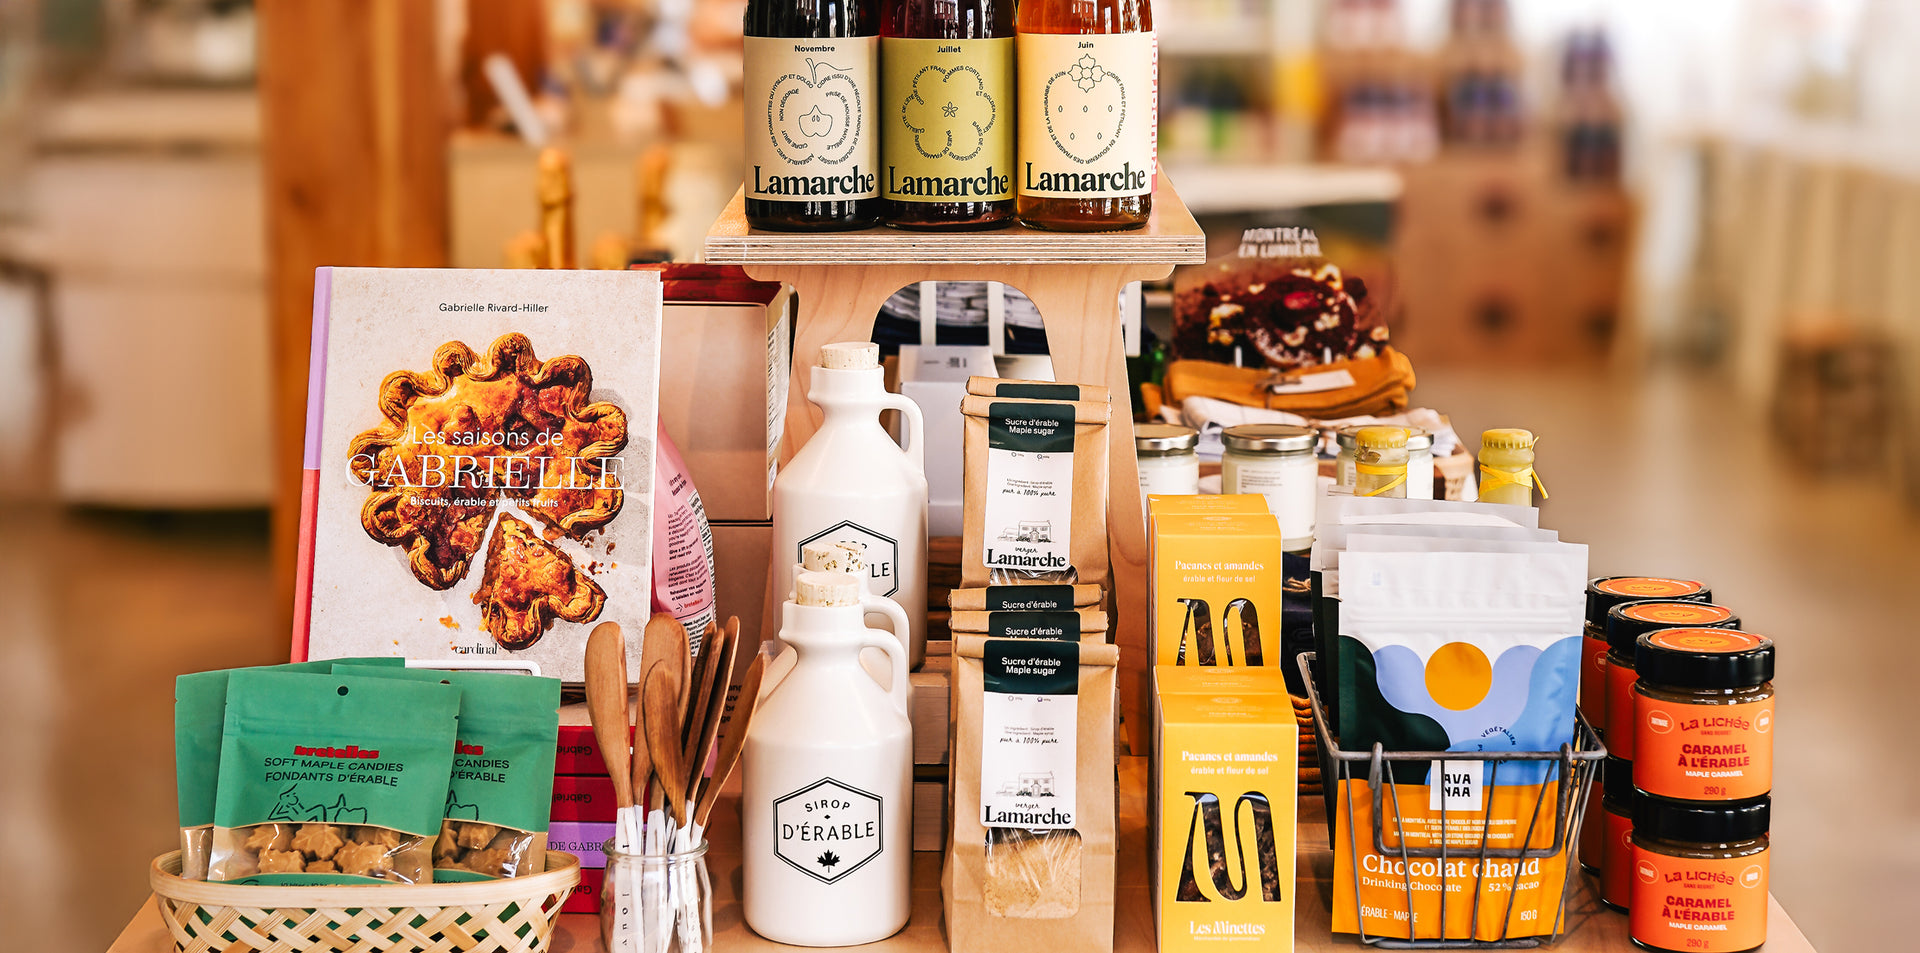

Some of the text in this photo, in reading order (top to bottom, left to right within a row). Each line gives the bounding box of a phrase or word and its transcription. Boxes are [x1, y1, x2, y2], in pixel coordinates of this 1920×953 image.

[937, 45, 961, 53] Juillet
[1078, 41, 1094, 49] Juin
[754, 164, 875, 196] Lamarche
[888, 165, 1009, 197] Lamarche
[1025, 161, 1146, 192] Lamarche
[439, 302, 549, 314] Gabrielle Rivard-Hiller
[1005, 418, 1060, 428] Sucre d'érable
[412, 426, 564, 447] Les saisons de
[1008, 426, 1055, 437] Maple sugar
[345, 453, 625, 490] GABRIELLE
[410, 496, 451, 508] Biscuits,
[453, 496, 486, 507] érable
[488, 498, 499, 507] et
[533, 497, 559, 508] fruits
[987, 548, 1067, 568] Lamarche
[1175, 560, 1265, 571] Pacanes et amandes
[1002, 600, 1058, 609] Sucre d'érable
[1005, 627, 1063, 636] Sucre d'érable
[455, 642, 499, 655] cardinal
[1001, 656, 1061, 667] Sucre d'érable
[1005, 665, 1057, 677] Maple sugar
[294, 745, 380, 759] bretelles
[556, 745, 593, 756] Gabrie
[1682, 743, 1747, 755] CARAMEL
[1181, 750, 1278, 762] Pacanes et amandes
[1678, 754, 1750, 768] À L'ÉRABLE
[264, 757, 404, 772] SOFT MAPLE CANDIES
[455, 758, 510, 769] CANDIES
[1190, 765, 1269, 775] érable et fleur de sel
[1685, 770, 1710, 778] MAPLE
[265, 771, 399, 787] FONDANTS D'ÉRABLE
[1444, 773, 1471, 785] AVA
[1703, 786, 1720, 795] 290
[553, 793, 593, 804] Gabriel
[804, 799, 851, 813] SIROP
[984, 805, 1072, 825] Lamarche
[782, 821, 876, 842] D'ÉRABLE
[549, 841, 604, 852] DE GABR
[1362, 853, 1540, 878] Chocolat chaud
[1362, 876, 1462, 892] Drinking Chocoate
[1488, 880, 1540, 892] 52 % acao
[1666, 895, 1732, 908] CARAMEL
[1361, 904, 1419, 923] ÉRABLE MAPE
[1661, 904, 1735, 921] À L'ÉRABLE
[1189, 920, 1212, 935] Les
[1668, 921, 1728, 931] MAPLE CARAMEL
[1686, 938, 1702, 948] 290
